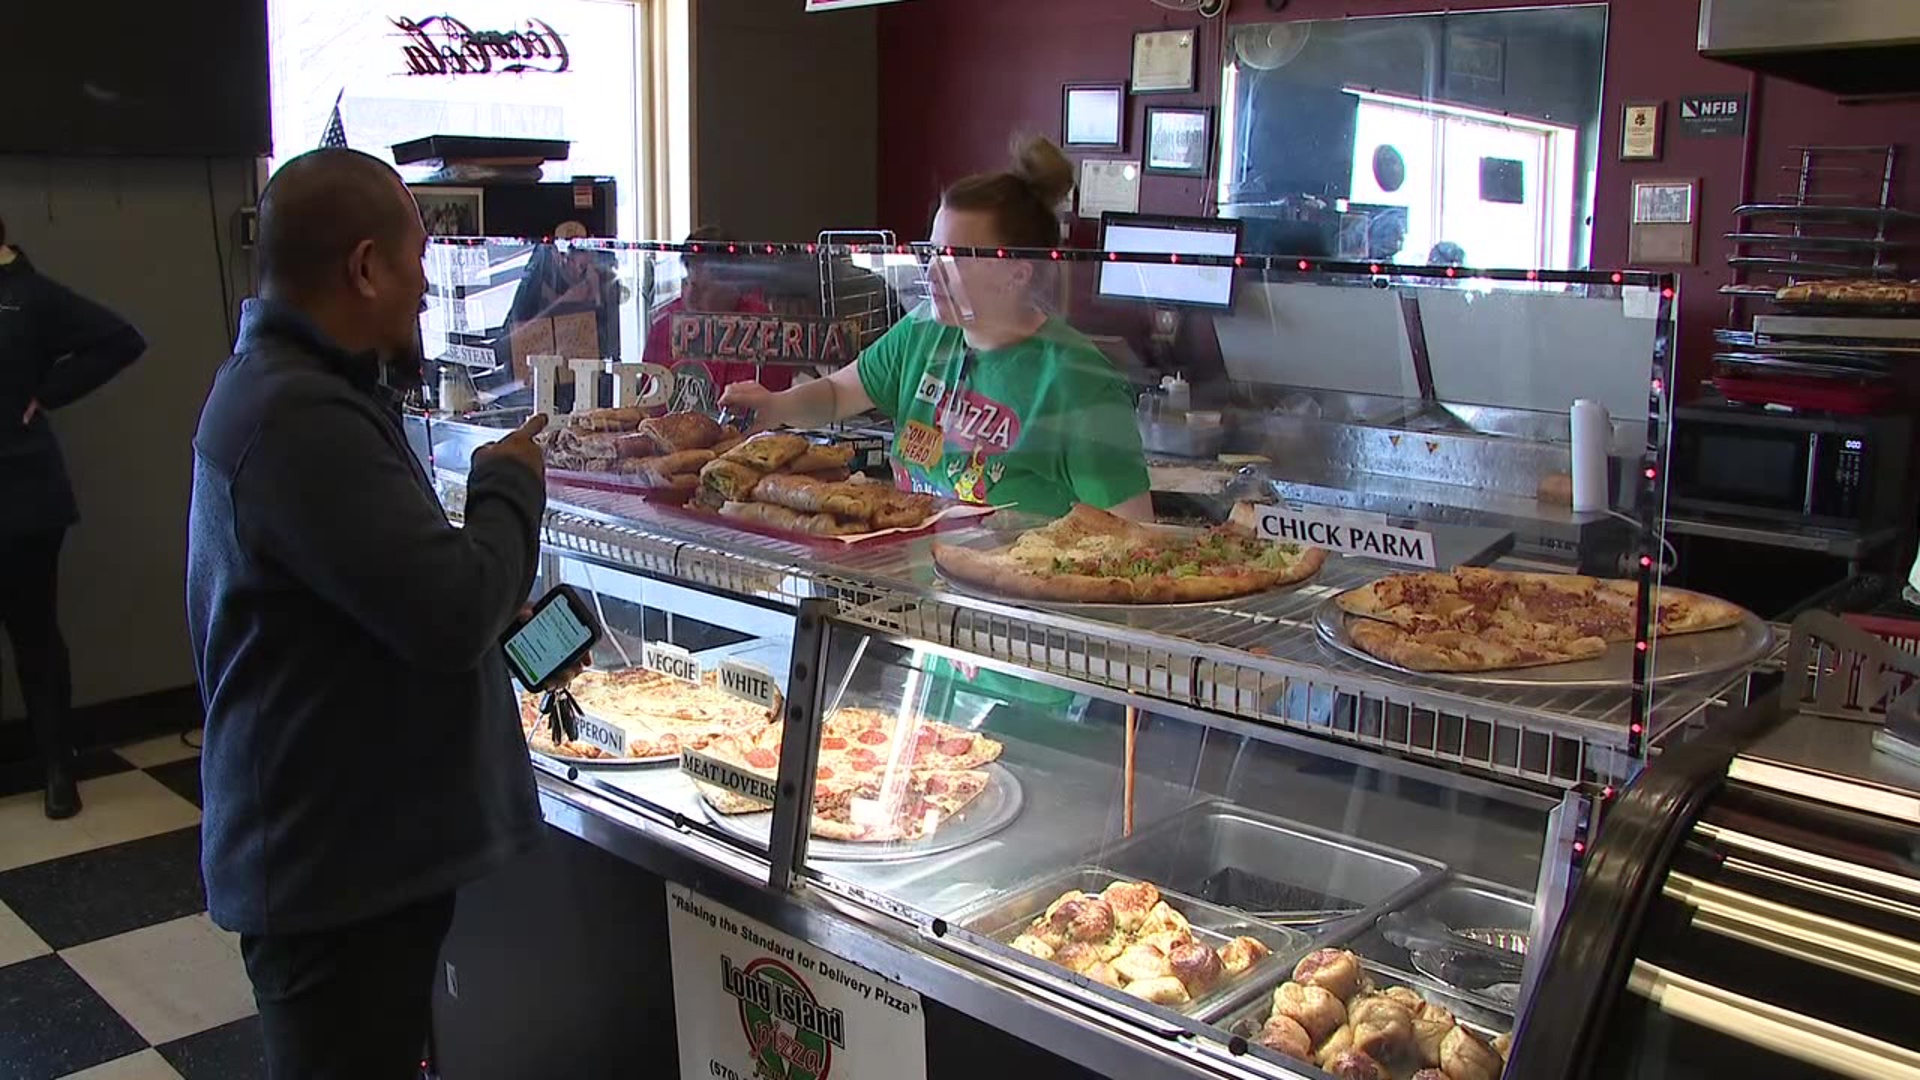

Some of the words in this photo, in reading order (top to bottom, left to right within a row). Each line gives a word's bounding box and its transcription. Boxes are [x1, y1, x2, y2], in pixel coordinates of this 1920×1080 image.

[1701, 101, 1738, 115] NFIB
[680, 317, 847, 359] PIZZERIA
[1262, 514, 1341, 547] CHICK
[1349, 528, 1424, 560] PARM
[647, 653, 697, 681] VEGGIE
[721, 667, 769, 700] WHITE
[683, 759, 718, 784] MEAT
[721, 768, 777, 801] LOVERS
[719, 917, 738, 936] the
[740, 927, 795, 961] Standard
[797, 952, 816, 970] for
[819, 962, 872, 999] Delivery
[721, 955, 772, 1012] Long
[773, 977, 845, 1049] Island
[749, 1020, 823, 1074] pizza
